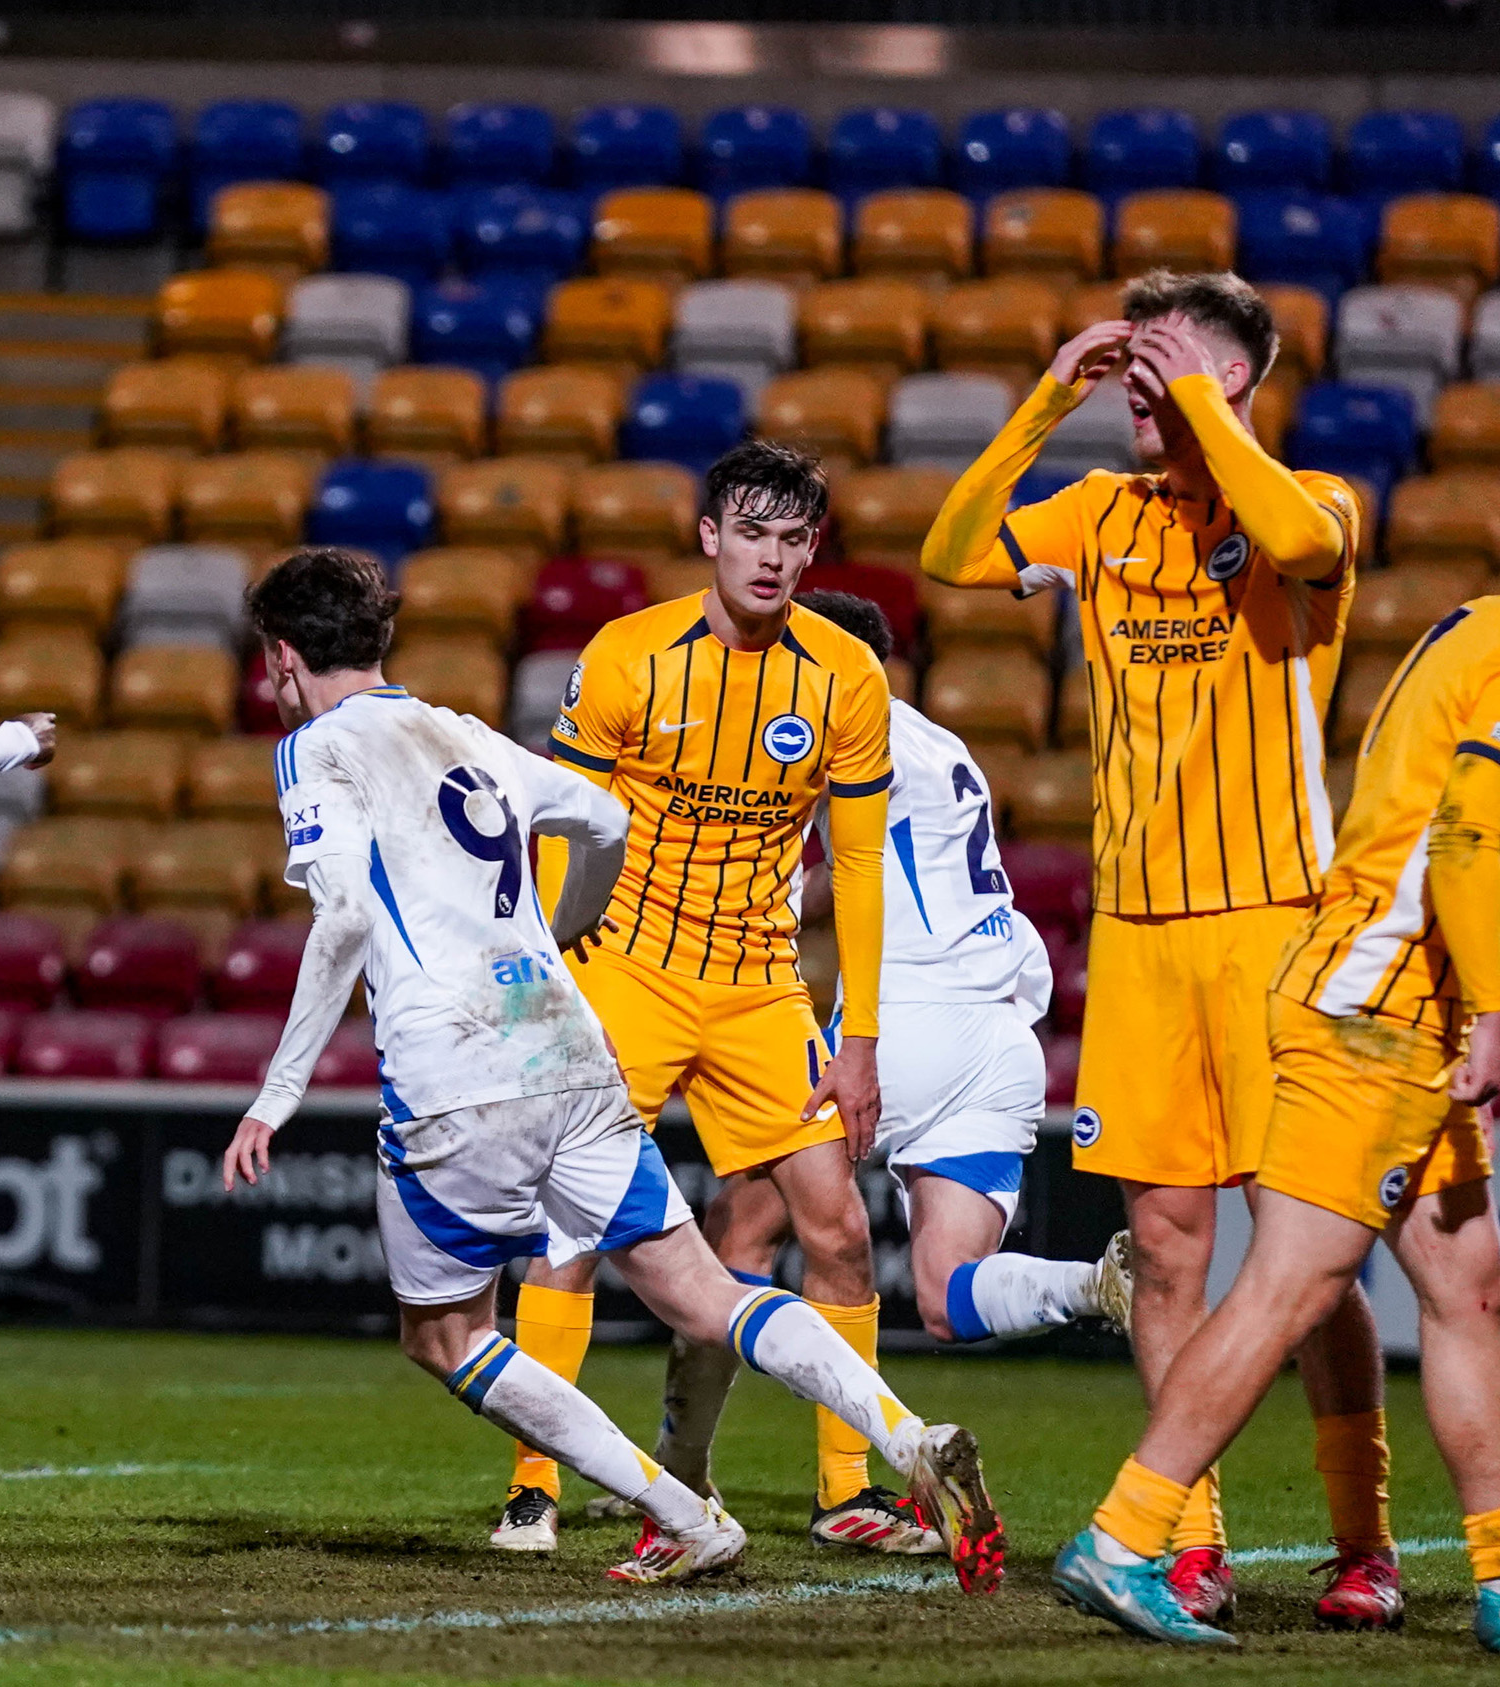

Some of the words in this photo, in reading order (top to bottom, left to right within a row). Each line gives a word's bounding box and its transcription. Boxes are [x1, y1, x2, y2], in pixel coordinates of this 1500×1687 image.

[437, 765, 523, 919] 9
[653, 775, 793, 808] AMERICAN
[951, 762, 1009, 895] 2
